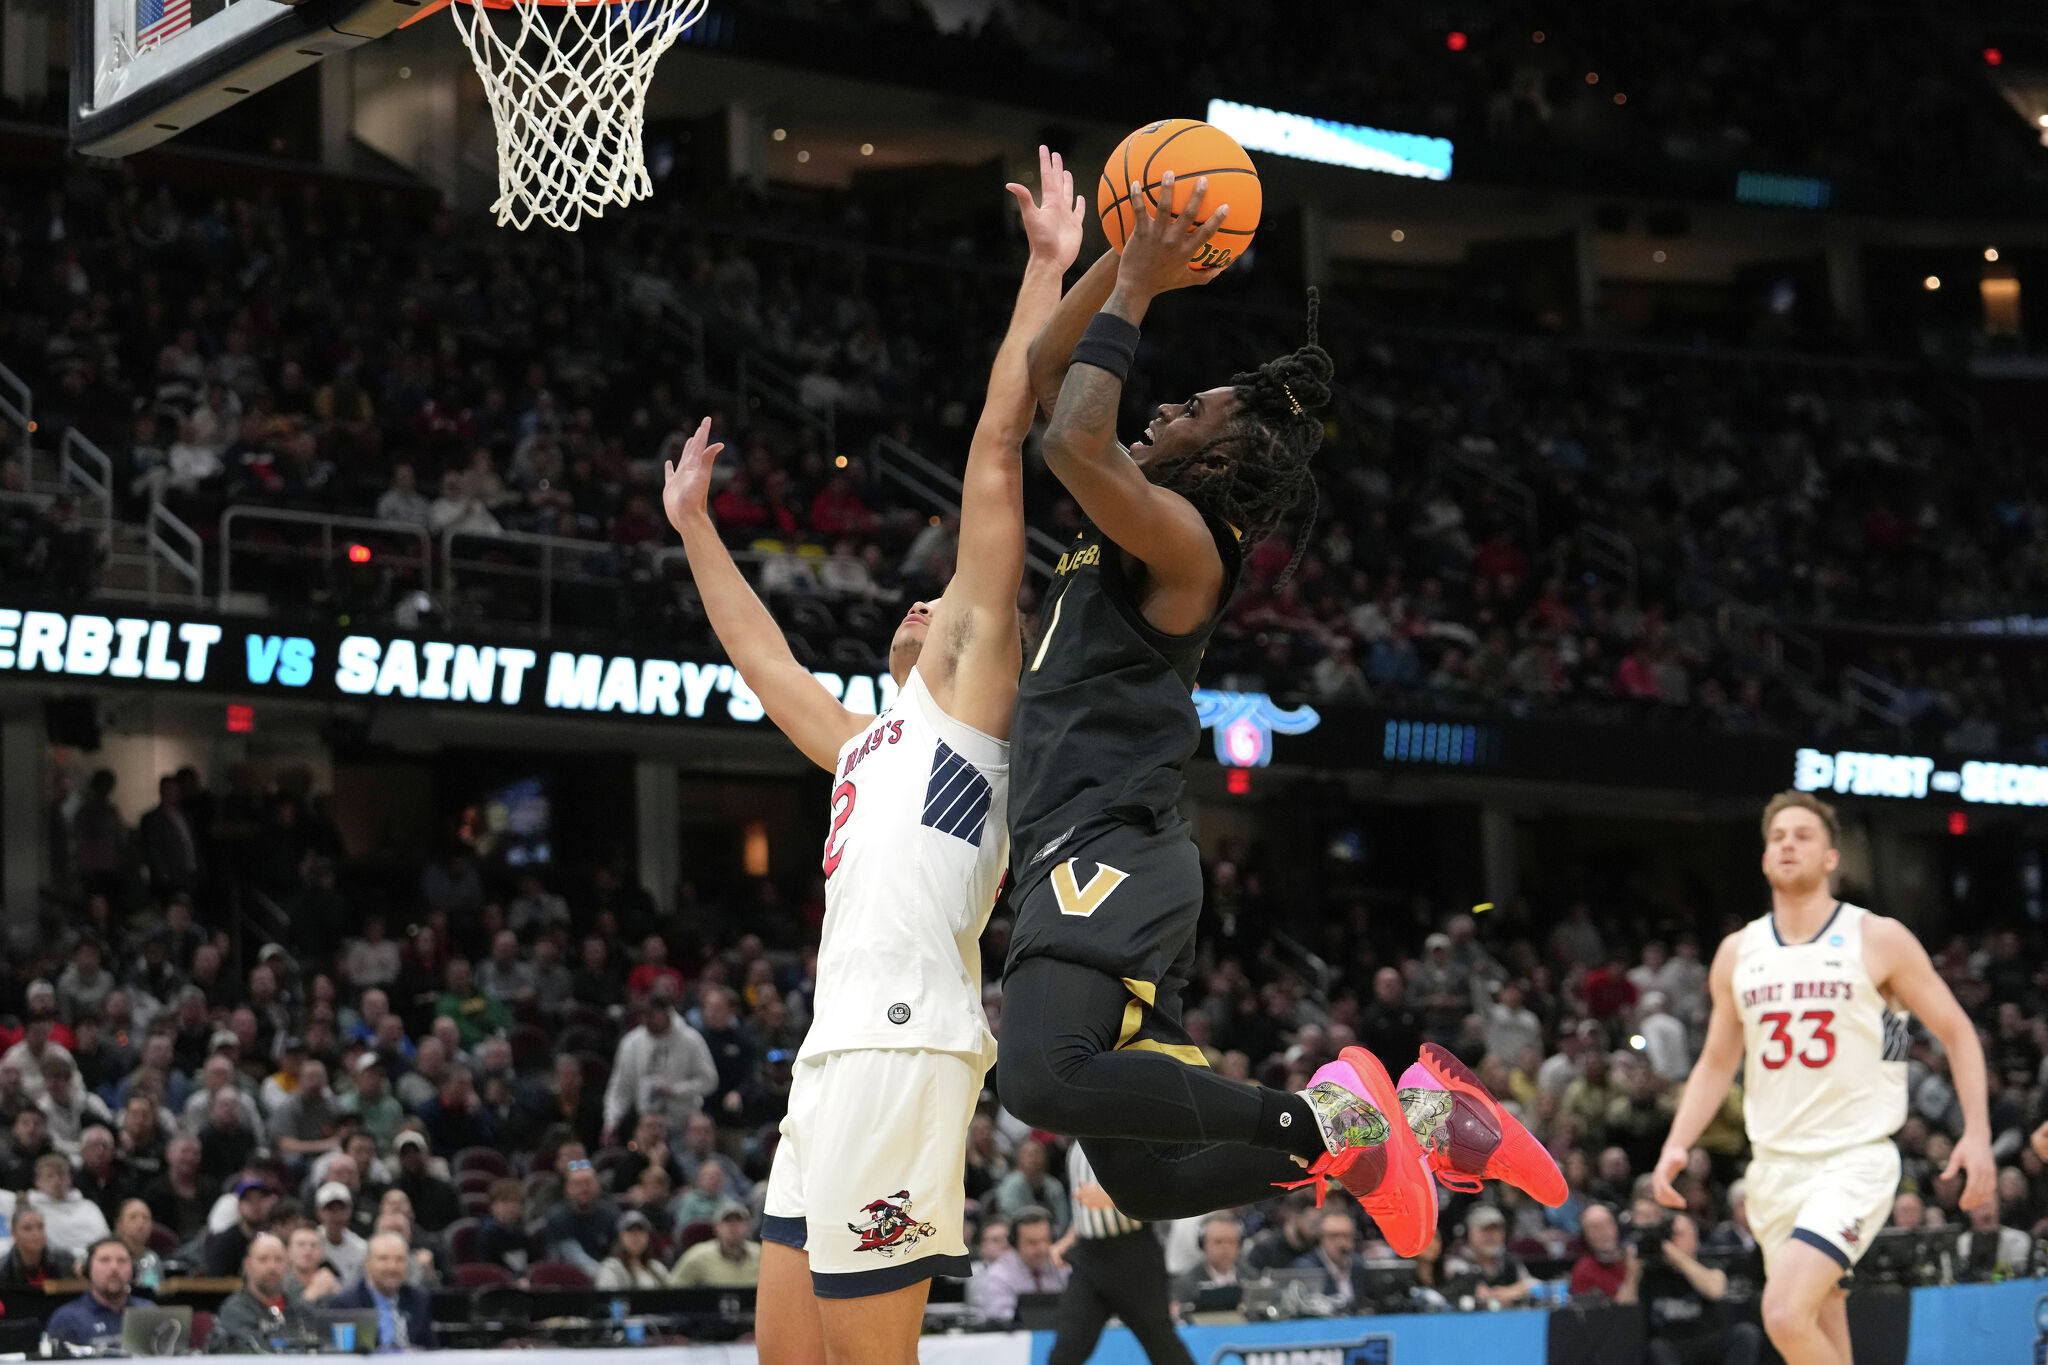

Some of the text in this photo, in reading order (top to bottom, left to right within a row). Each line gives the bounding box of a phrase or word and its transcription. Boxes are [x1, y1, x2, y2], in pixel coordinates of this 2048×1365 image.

[246, 633, 315, 687] VS
[335, 635, 536, 705] SAINT
[545, 651, 766, 722] MARY'S
[1743, 984, 1783, 1008] SAINT
[1759, 1010, 1836, 1069] 33
